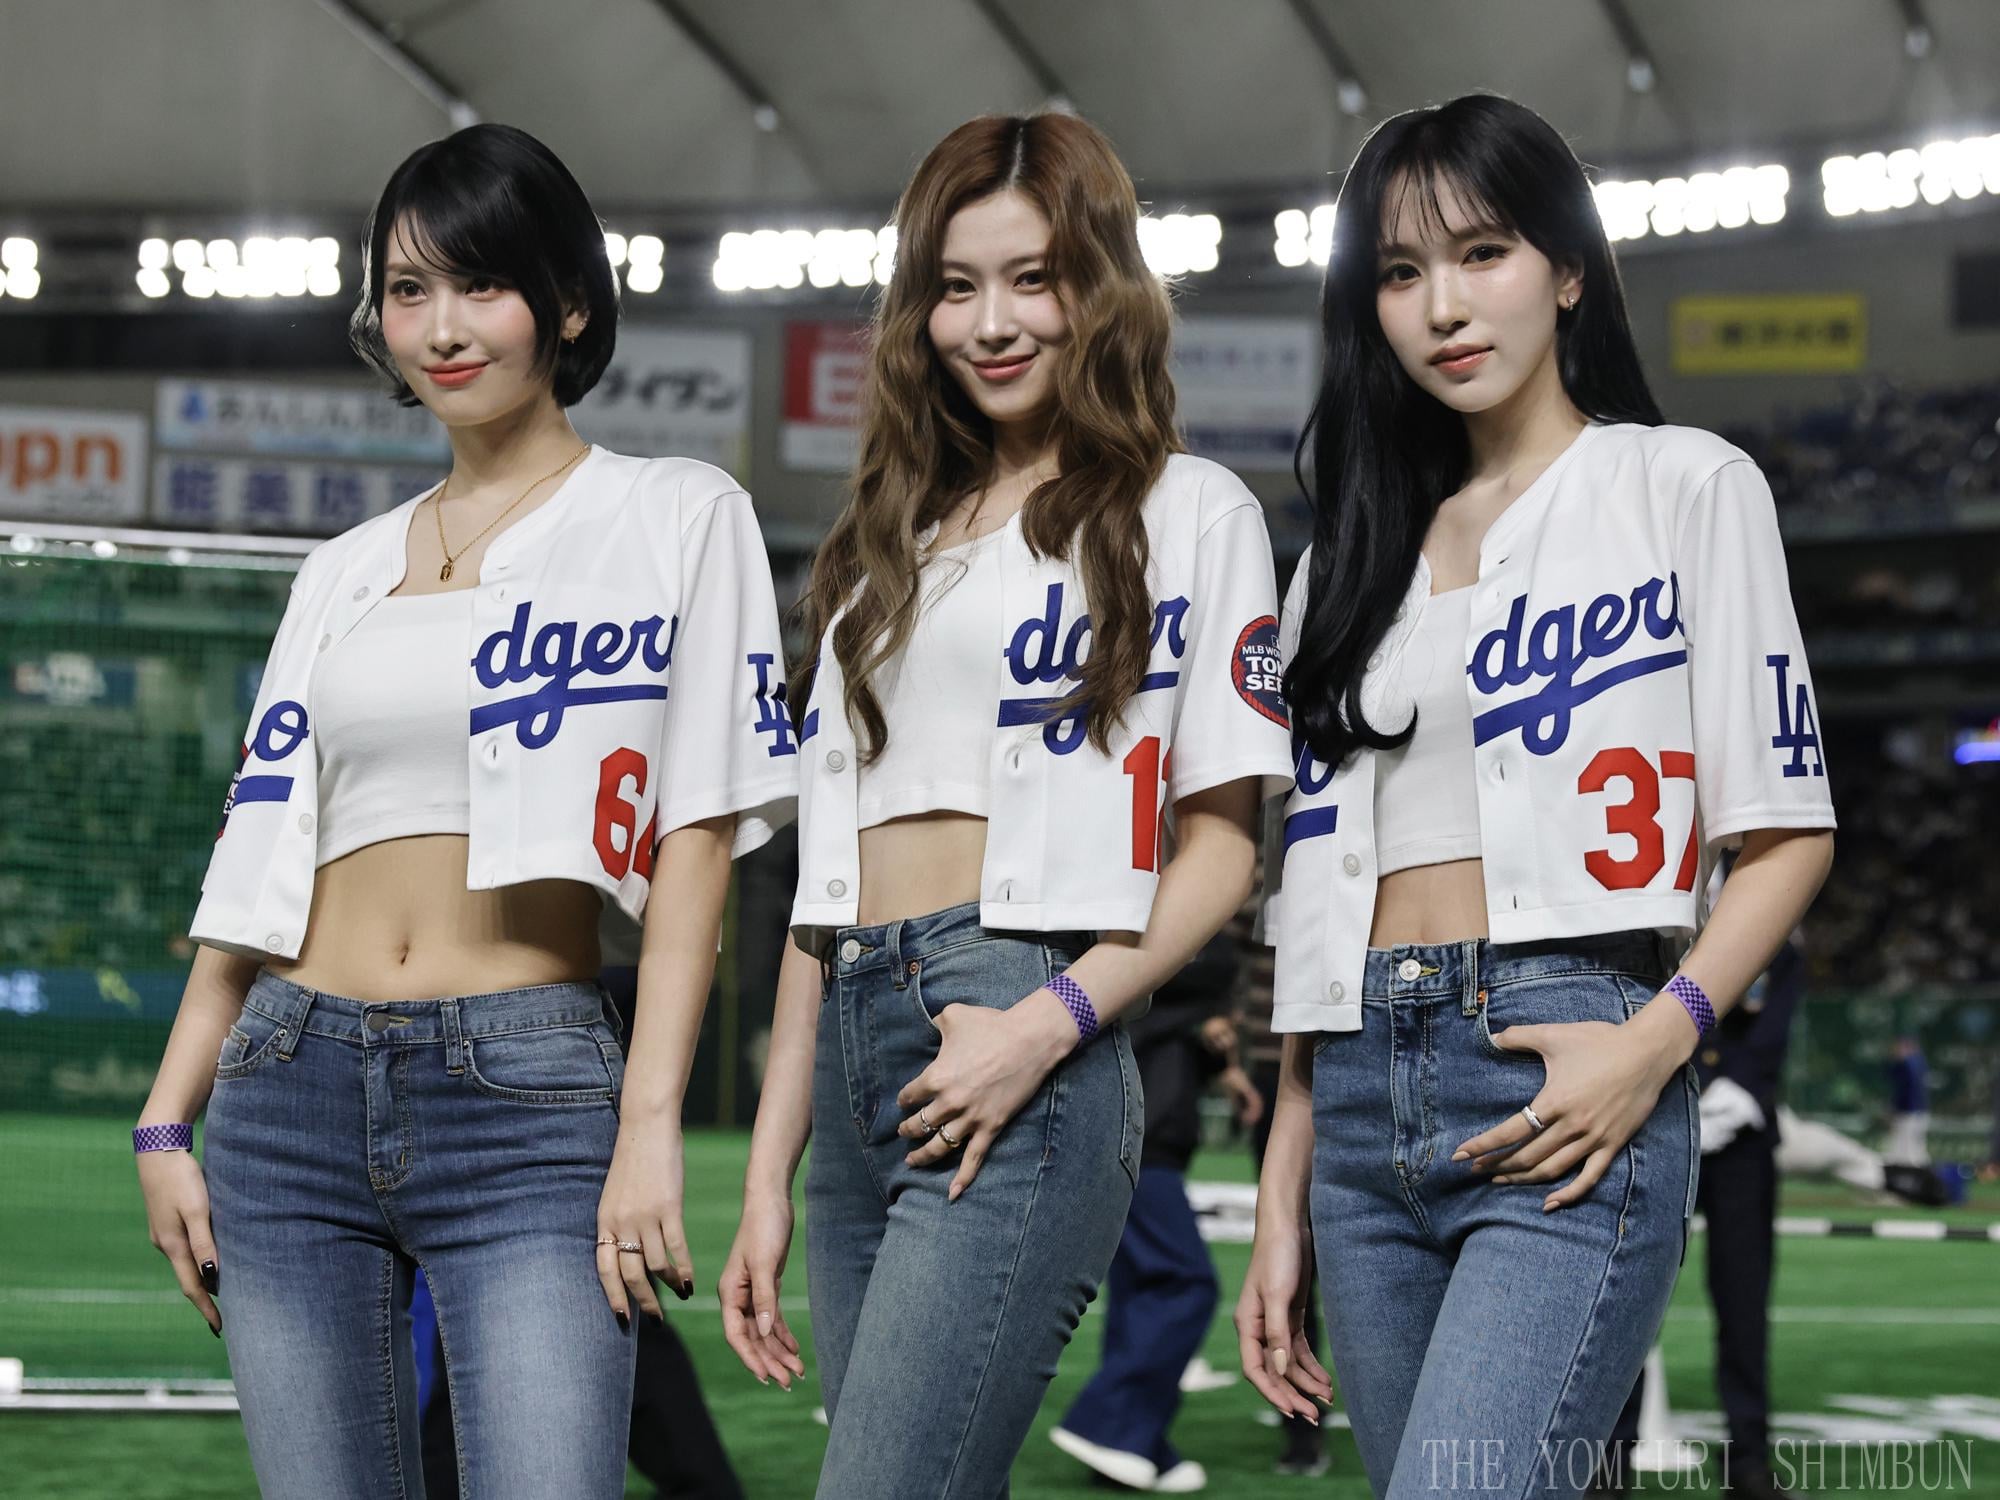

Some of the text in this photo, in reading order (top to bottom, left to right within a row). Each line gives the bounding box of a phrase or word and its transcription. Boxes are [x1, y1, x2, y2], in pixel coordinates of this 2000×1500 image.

[0, 432, 121, 491] pn
[470, 600, 679, 750] dger
[1242, 645, 1265, 656] MLB
[1766, 654, 1824, 778] LA
[1123, 736, 1171, 876] 1
